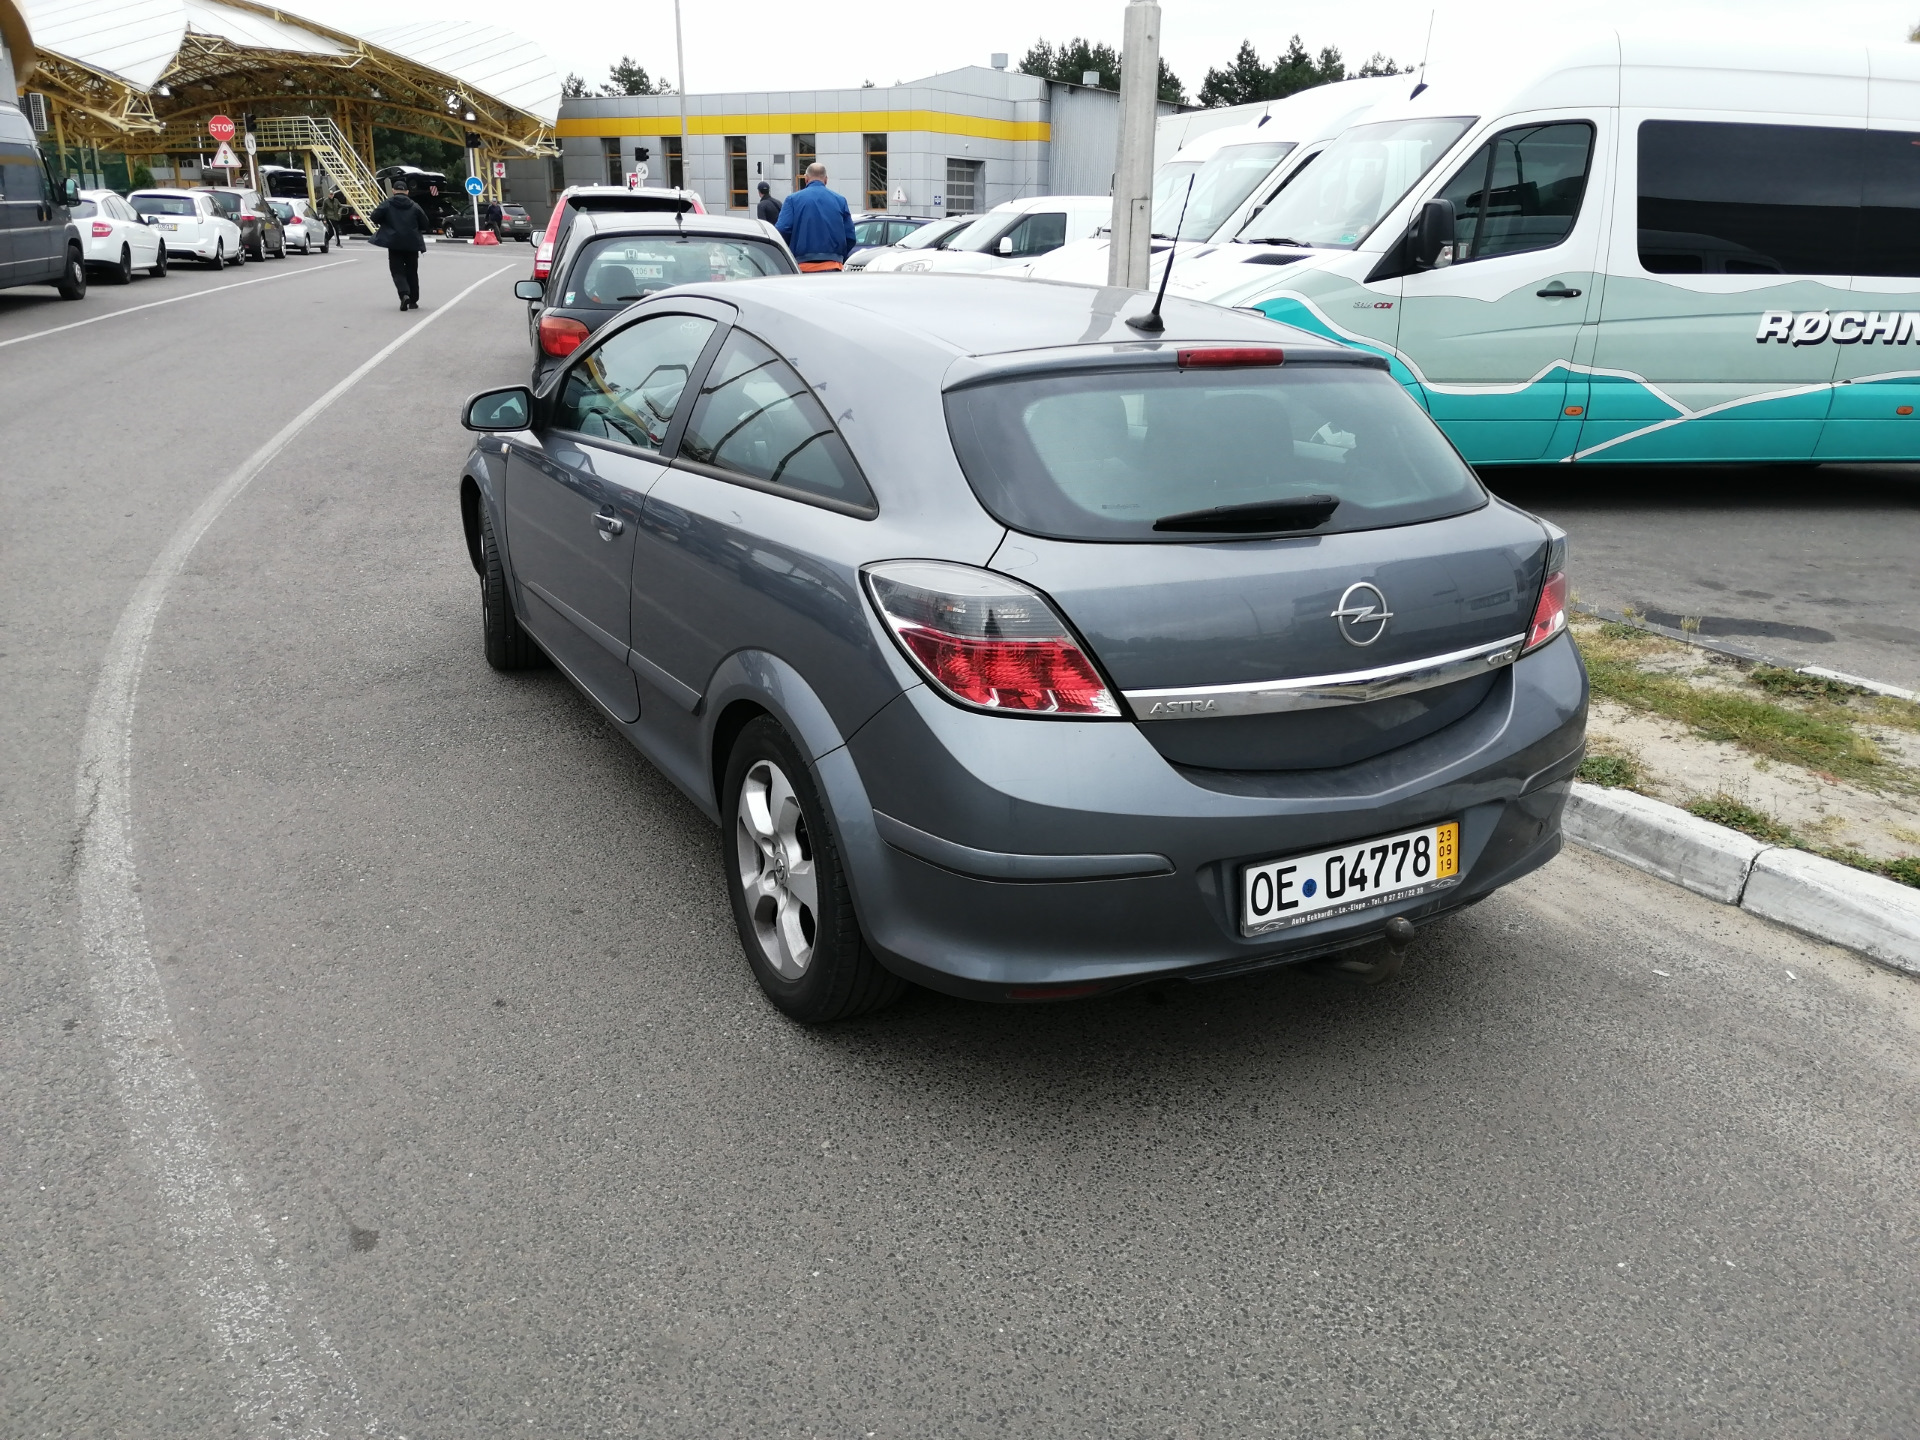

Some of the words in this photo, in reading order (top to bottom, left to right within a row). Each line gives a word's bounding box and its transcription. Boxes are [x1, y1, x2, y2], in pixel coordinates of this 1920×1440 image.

[210, 123, 234, 133] STOP
[1149, 699, 1216, 714] ASTRA
[1438, 829, 1452, 844] 23
[1438, 843, 1452, 857] 09
[1440, 858, 1452, 871] 19
[1250, 865, 1299, 917] OE
[1325, 835, 1431, 900] 04778
[1291, 917, 1306, 925] Auto
[1306, 909, 1333, 922] Eckhardt
